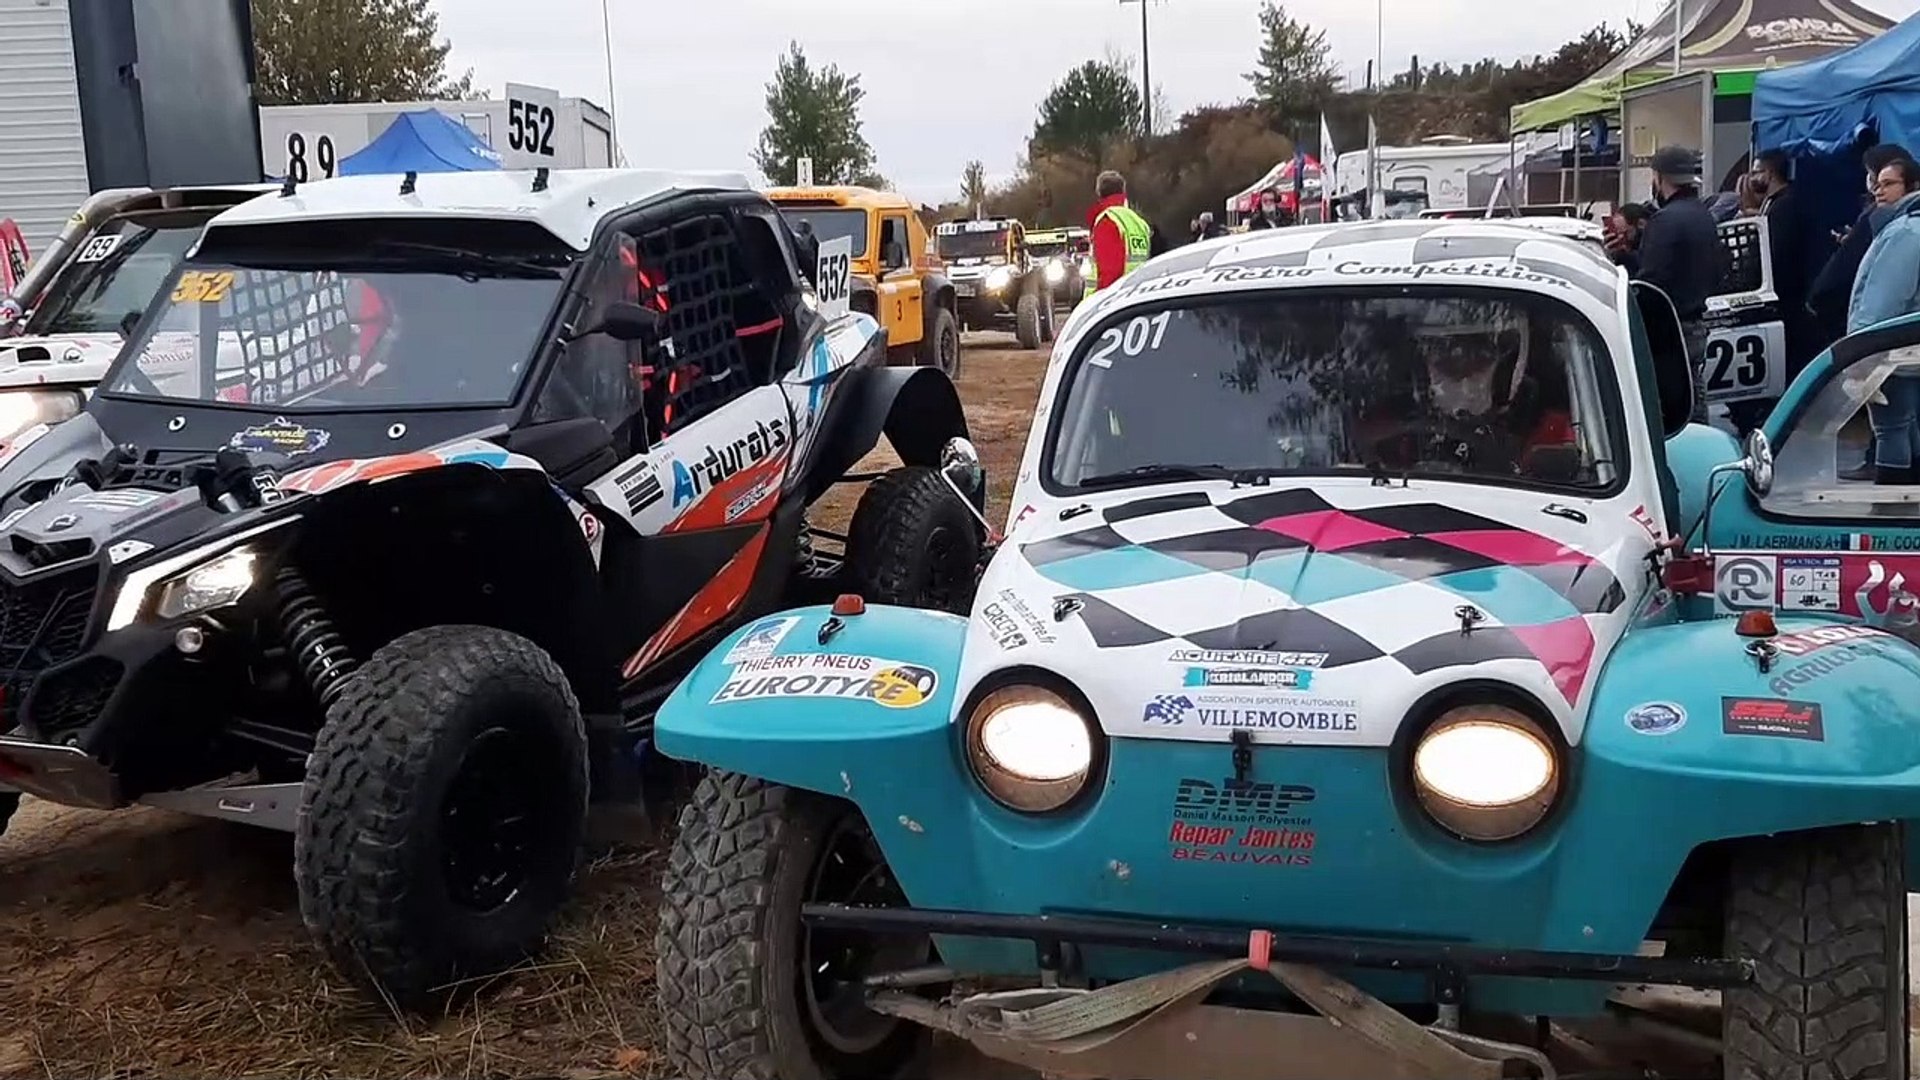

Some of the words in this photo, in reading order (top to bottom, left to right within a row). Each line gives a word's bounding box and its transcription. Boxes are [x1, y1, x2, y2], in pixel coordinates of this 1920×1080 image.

[508, 99, 555, 156] 552
[84, 238, 115, 260] 89
[171, 272, 234, 302] 552
[819, 254, 848, 302] 552
[1089, 310, 1171, 369] 201
[1706, 335, 1766, 391] 23
[737, 656, 807, 673] THIERRY
[811, 654, 872, 671] PNEUS
[716, 674, 907, 701] EUROTYRE
[1197, 696, 1253, 705] ASSOCIATION
[1256, 697, 1297, 706] SPORTIVE
[1300, 698, 1356, 708] AUTOMOBILE
[1198, 710, 1357, 731] VILLEMOMBLE
[1174, 778, 1316, 813] DMP
[1173, 808, 1208, 821] Daniel
[1211, 813, 1255, 824] Masson
[1258, 815, 1312, 827] Polyester
[1170, 821, 1234, 847] Repar
[1239, 826, 1315, 850] Jantes
[1172, 848, 1312, 865] BEAUVAIS
